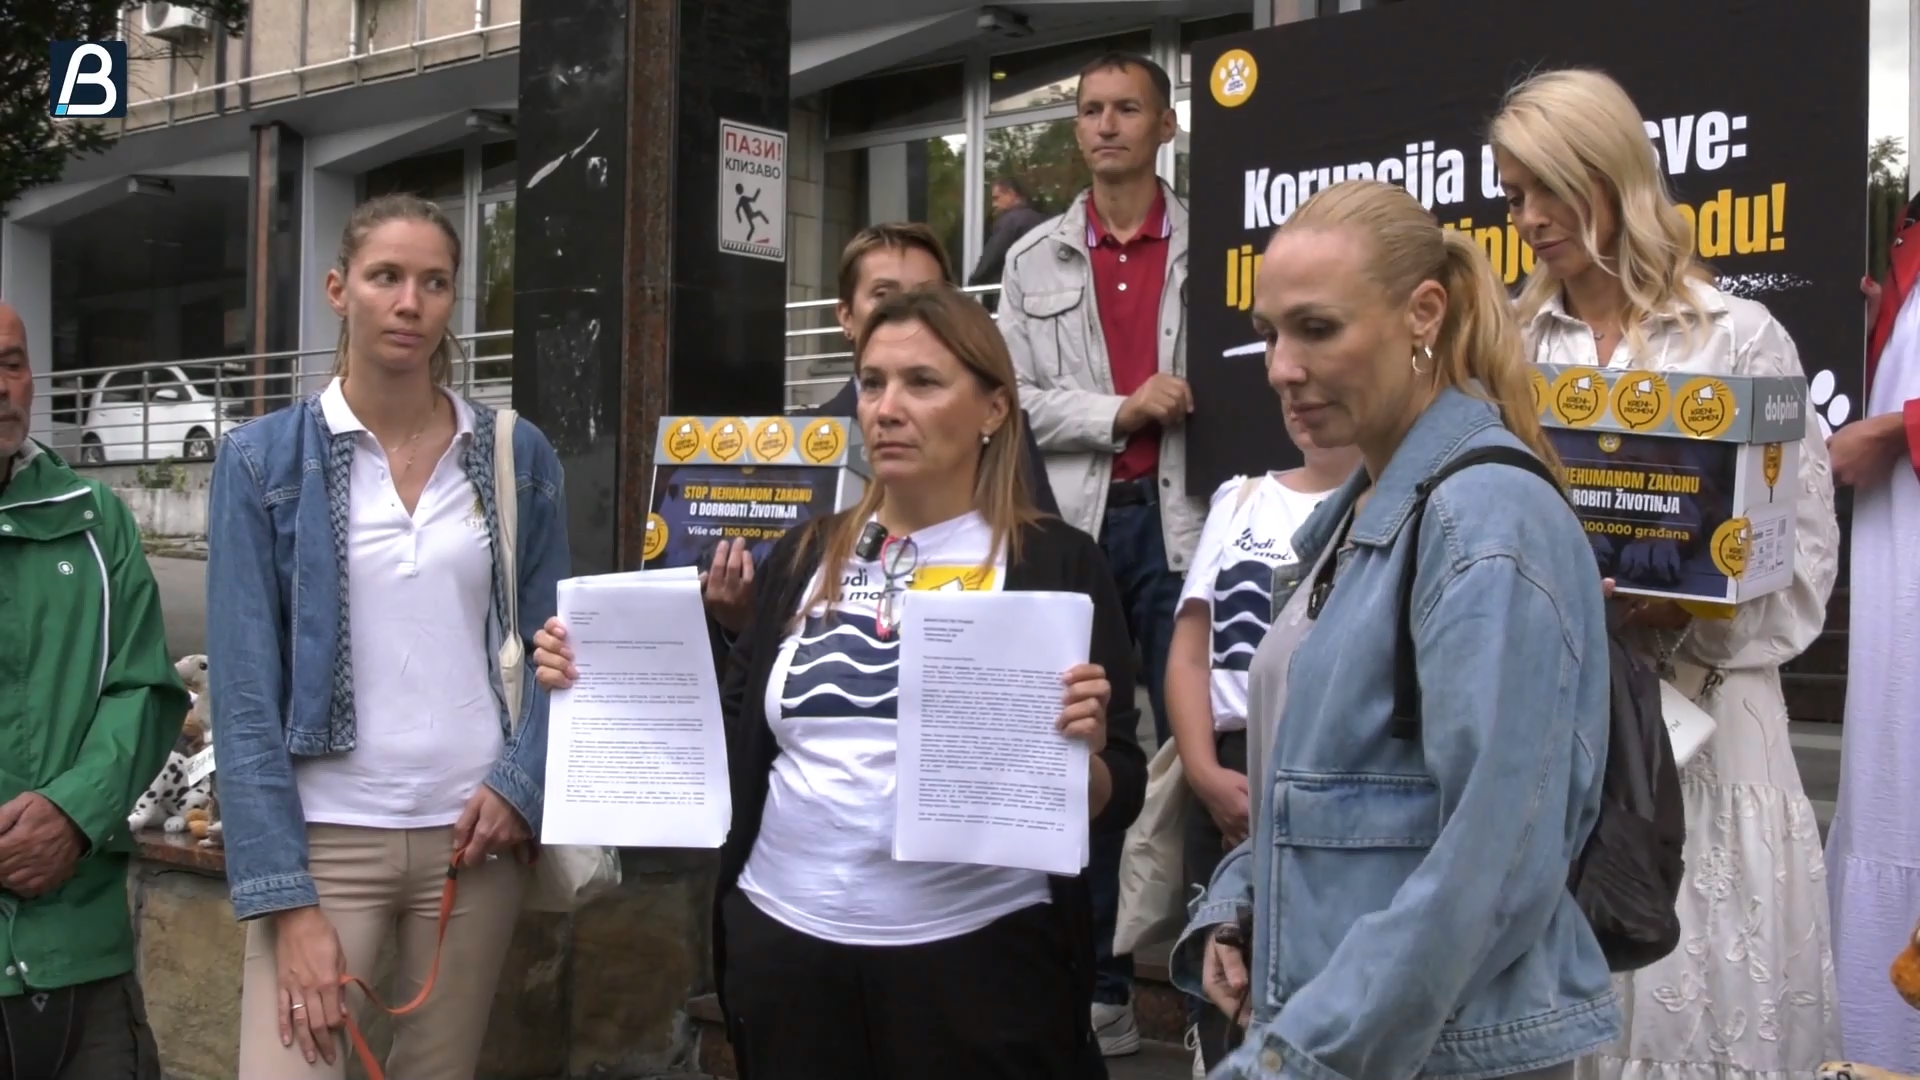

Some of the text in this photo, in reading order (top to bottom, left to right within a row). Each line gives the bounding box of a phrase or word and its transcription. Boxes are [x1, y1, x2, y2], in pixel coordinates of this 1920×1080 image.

[725, 131, 782, 161] ПАЗИ!
[1643, 111, 1748, 175] ve:
[725, 156, 781, 180] КЛИЗАВО
[1765, 394, 1799, 425] dolphin
[1565, 466, 1700, 494] EHUMANOM ZAKONU
[684, 485, 813, 503] STOP NEHUMANOM ZAKONU
[1572, 488, 1681, 514] ROBITI ŽIVOTINJA
[689, 501, 798, 519] O DOBROBITI ŽIVOTINJA
[688, 526, 708, 536] Više
[709, 526, 723, 536] od
[724, 527, 761, 537] 100.000
[1583, 520, 1632, 535] 100.000
